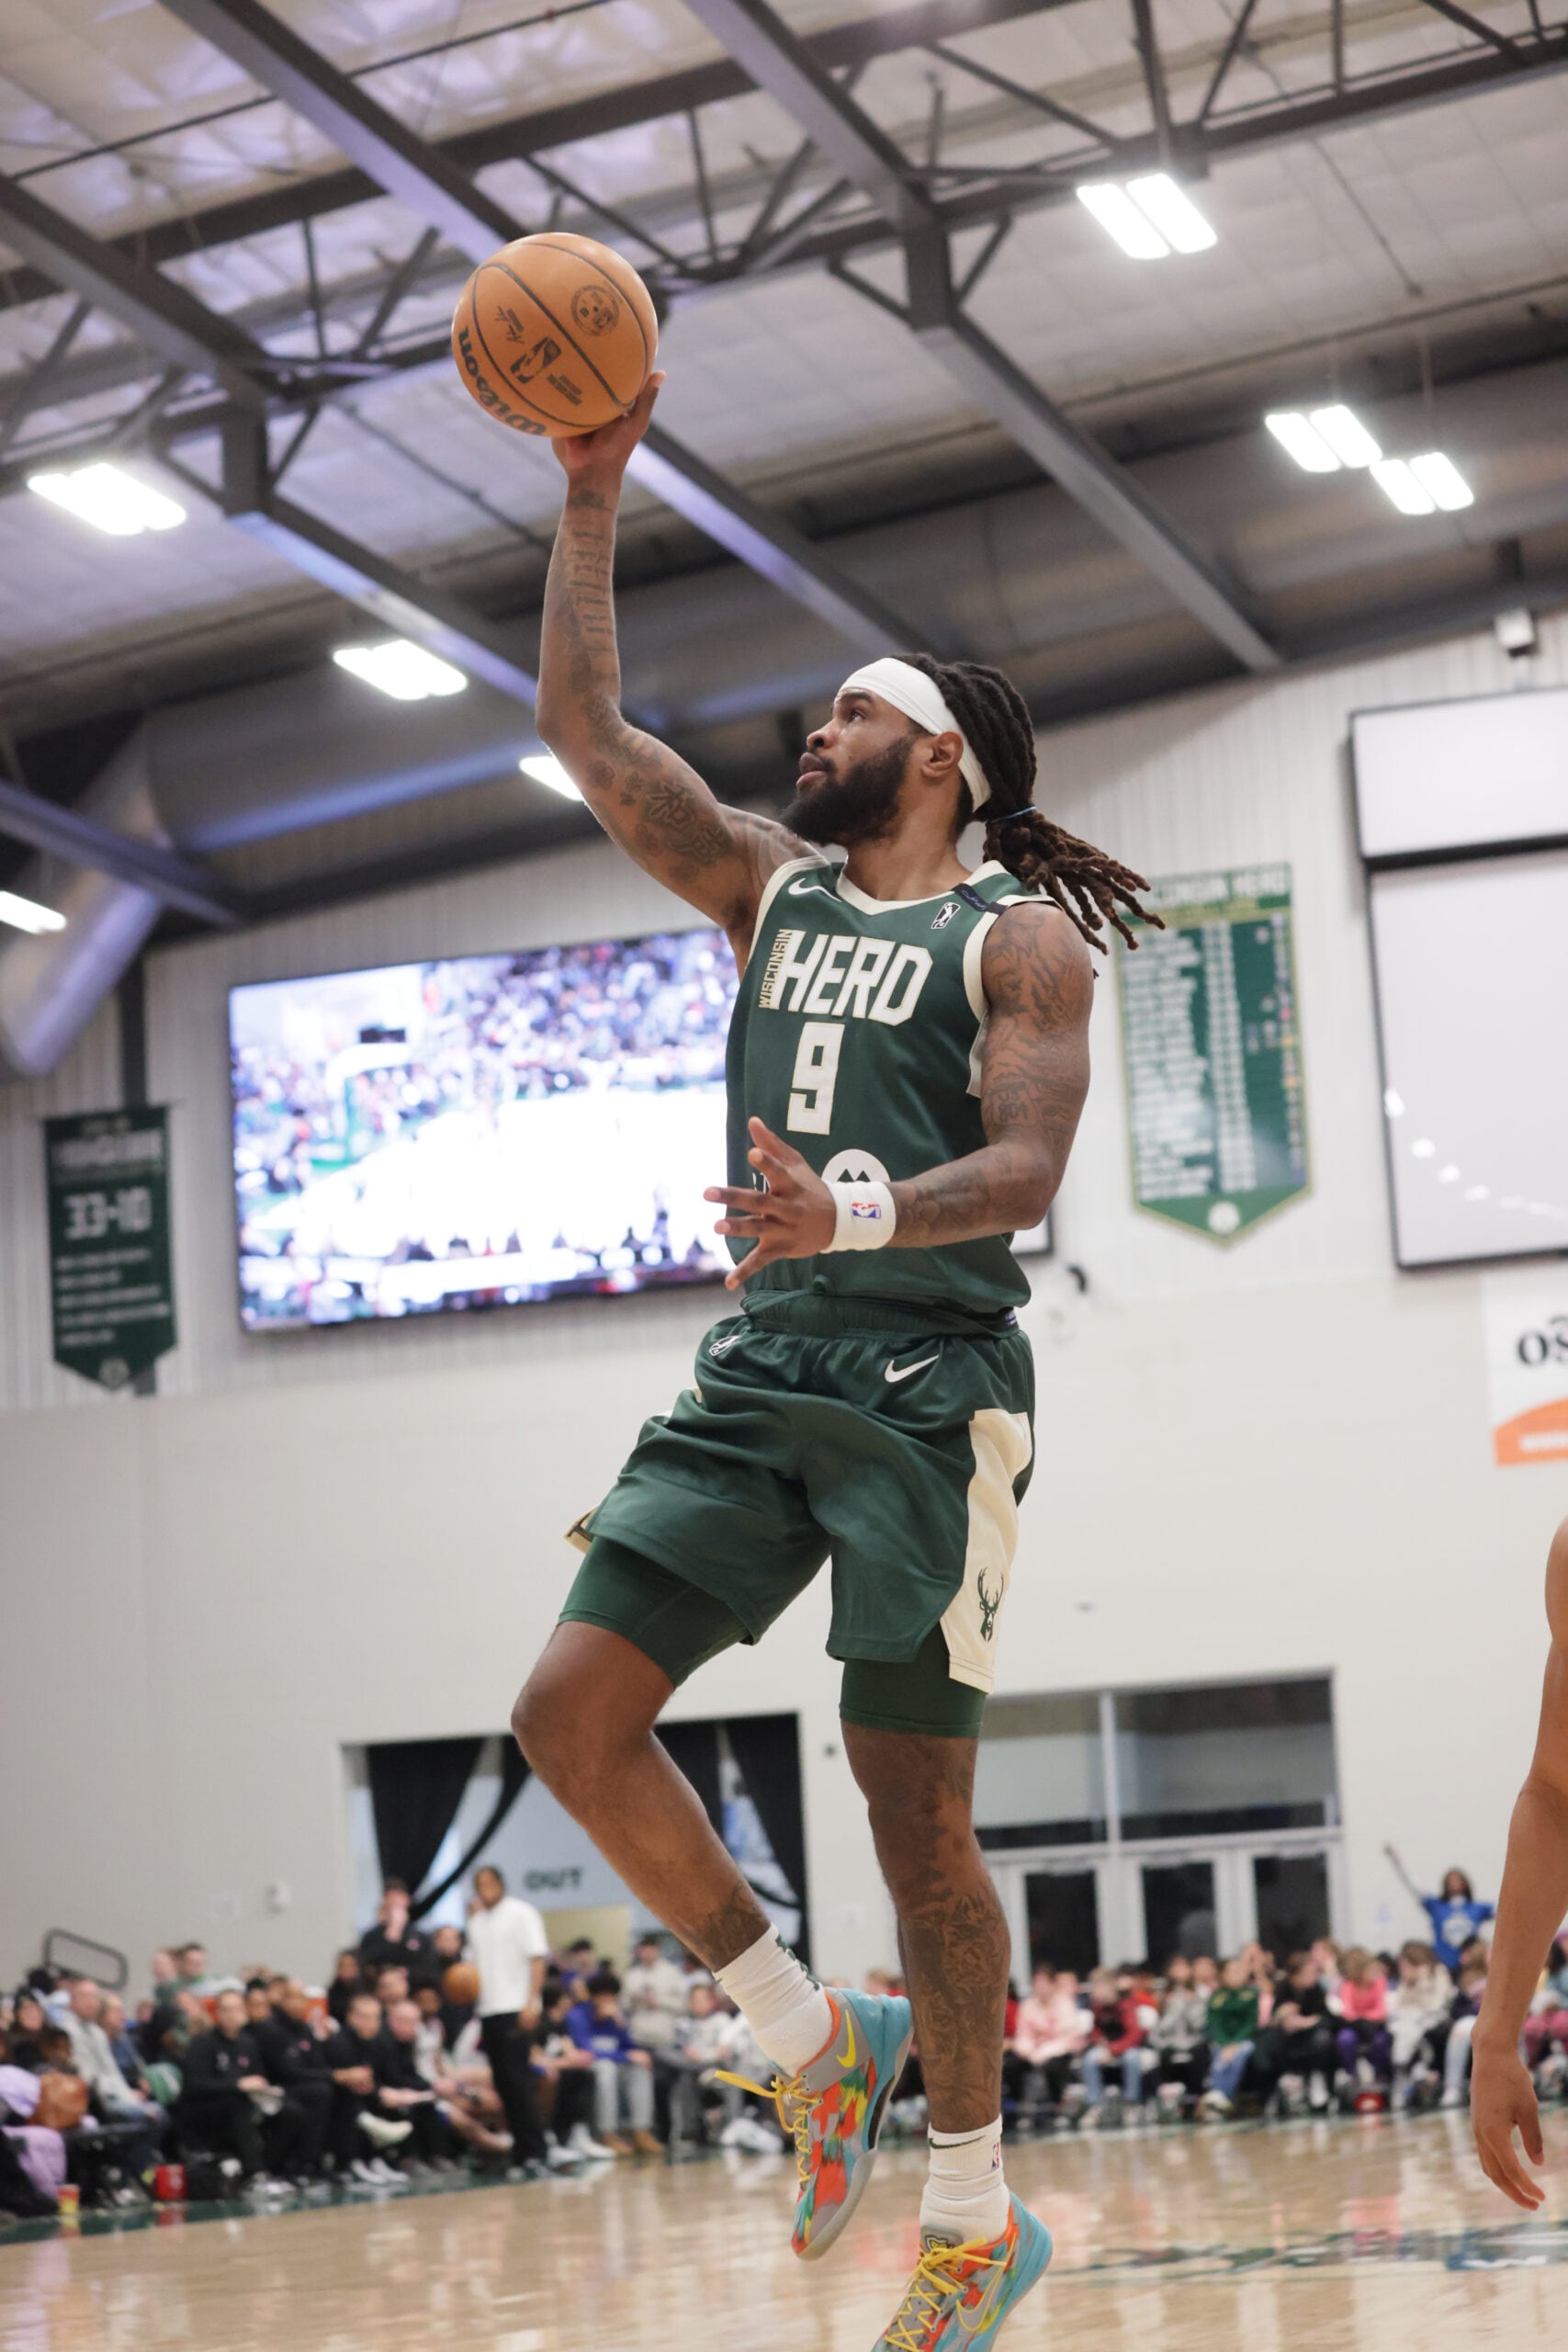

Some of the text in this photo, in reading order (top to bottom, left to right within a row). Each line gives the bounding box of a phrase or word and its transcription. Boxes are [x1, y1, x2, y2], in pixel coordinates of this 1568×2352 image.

[457, 326, 547, 436] Wilson
[758, 928, 794, 1009] WISCONSIN
[775, 930, 933, 1027] HERD
[786, 1021, 846, 1136] 9
[523, 1867, 586, 1893] OUT
